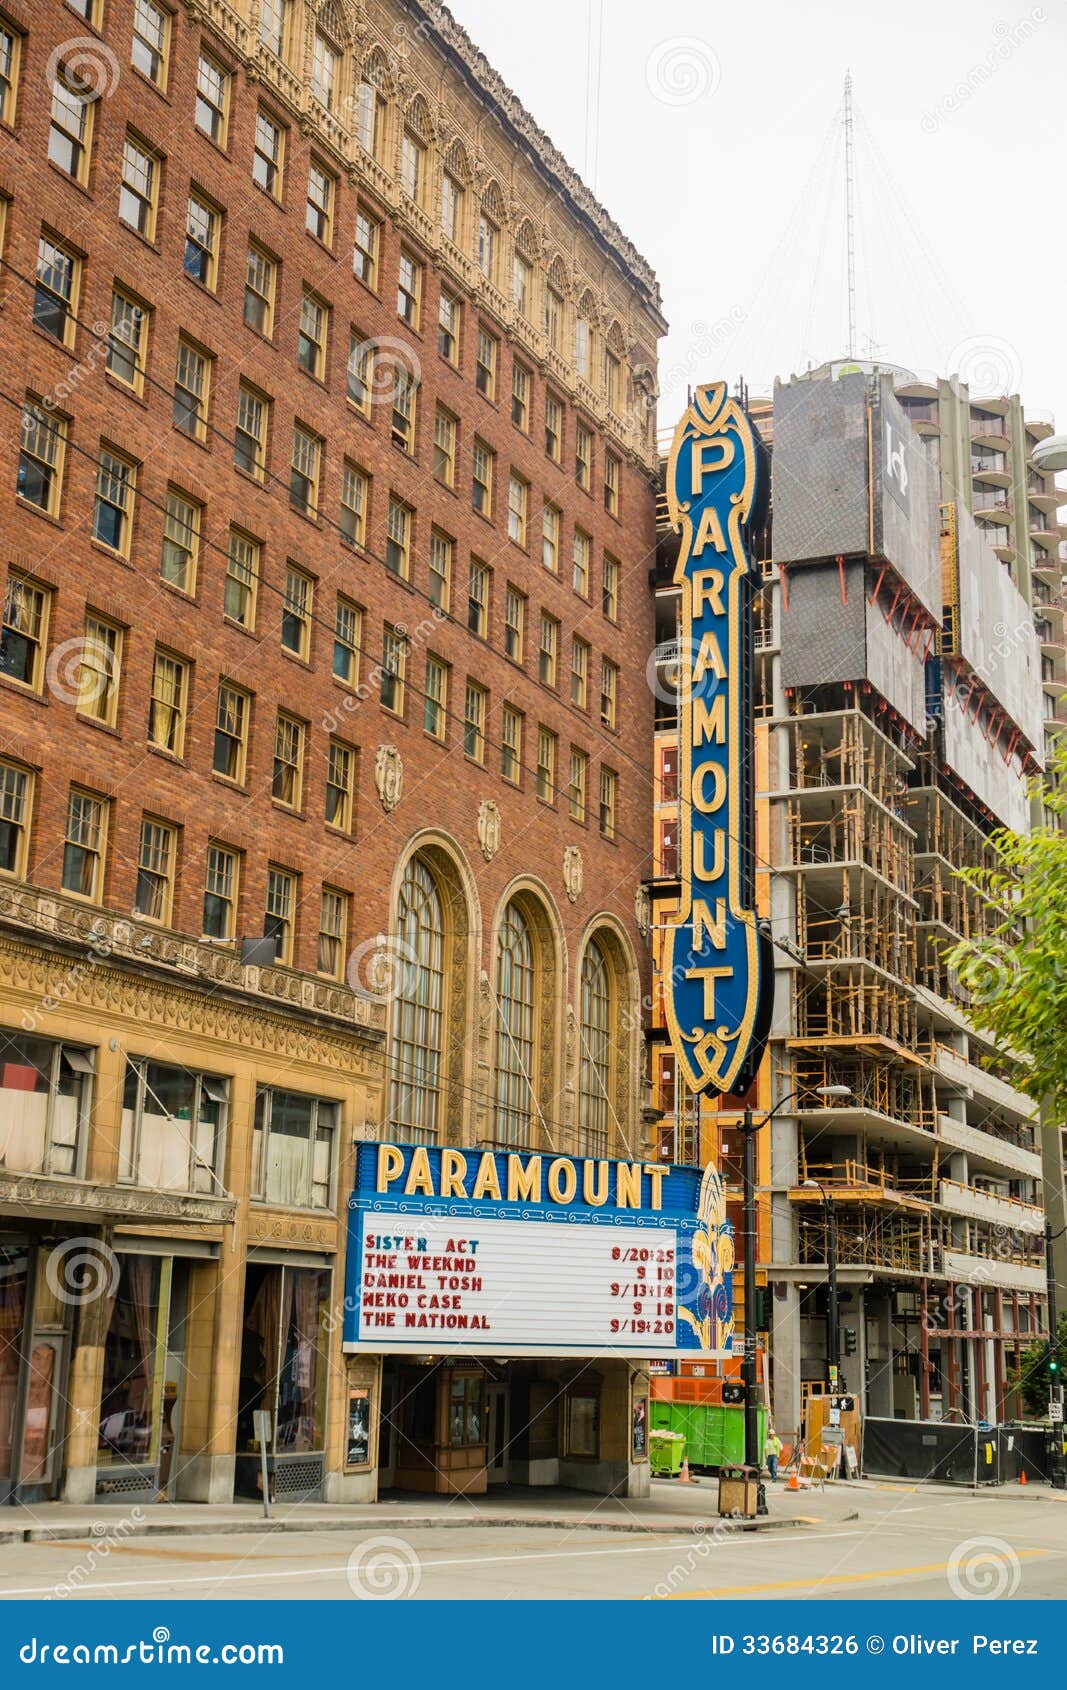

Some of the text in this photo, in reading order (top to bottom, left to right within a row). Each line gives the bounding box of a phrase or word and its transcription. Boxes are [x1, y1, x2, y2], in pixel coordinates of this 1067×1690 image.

[685, 435, 734, 1021] PARAMOUNT
[377, 1143, 670, 1210] PARAMOUNT
[365, 1234, 427, 1252] SISTER
[445, 1238, 479, 1254] ACT
[365, 1253, 397, 1268] THE
[407, 1255, 476, 1272] WEEKND
[637, 1265, 646, 1280] 9
[364, 1273, 426, 1289] DANIEL
[438, 1275, 482, 1291] TOSH
[362, 1292, 409, 1308] NEKO
[417, 1294, 462, 1309] CASE
[633, 1301, 642, 1315] 9
[363, 1311, 395, 1327] THE
[405, 1312, 490, 1329] NATIONAL
